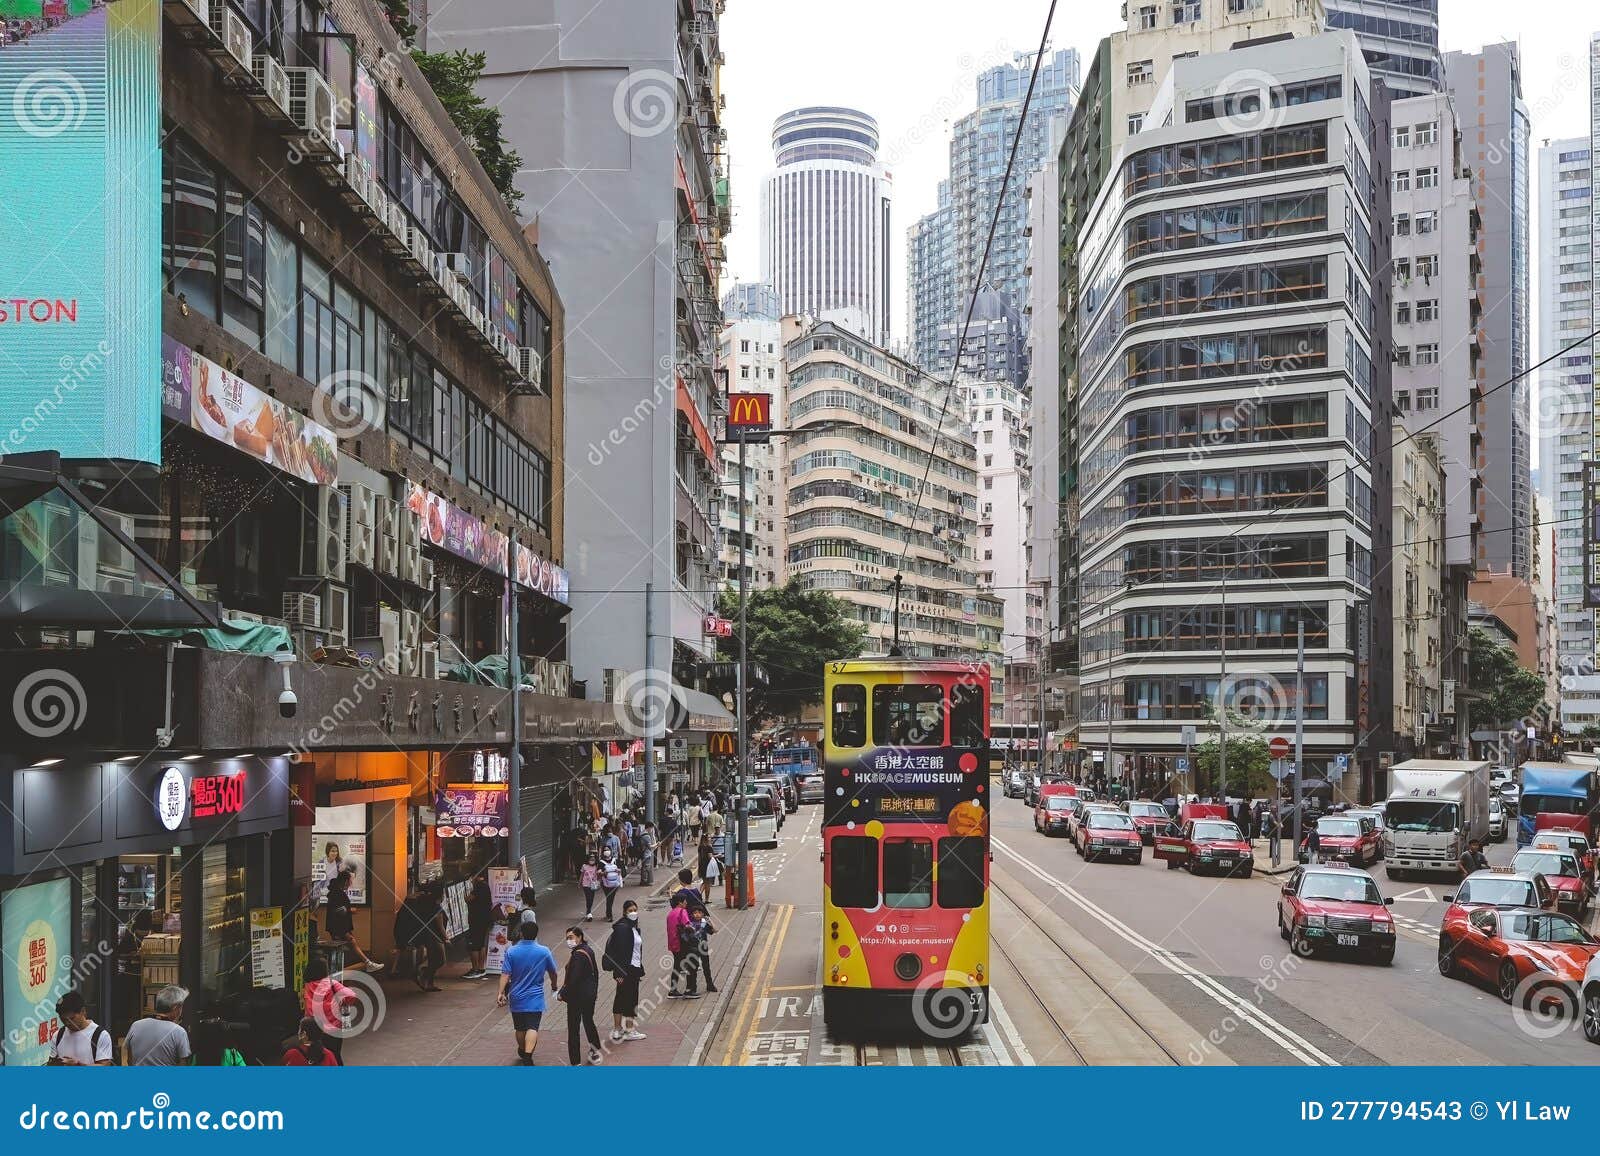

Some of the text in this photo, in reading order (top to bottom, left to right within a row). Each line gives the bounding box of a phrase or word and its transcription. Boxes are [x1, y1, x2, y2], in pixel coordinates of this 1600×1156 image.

[831, 663, 847, 673] 57
[968, 663, 982, 673] 57
[875, 756, 944, 770] 香港太空館
[860, 936, 954, 946] https://hk.space.museum
[970, 993, 983, 1004] 57
